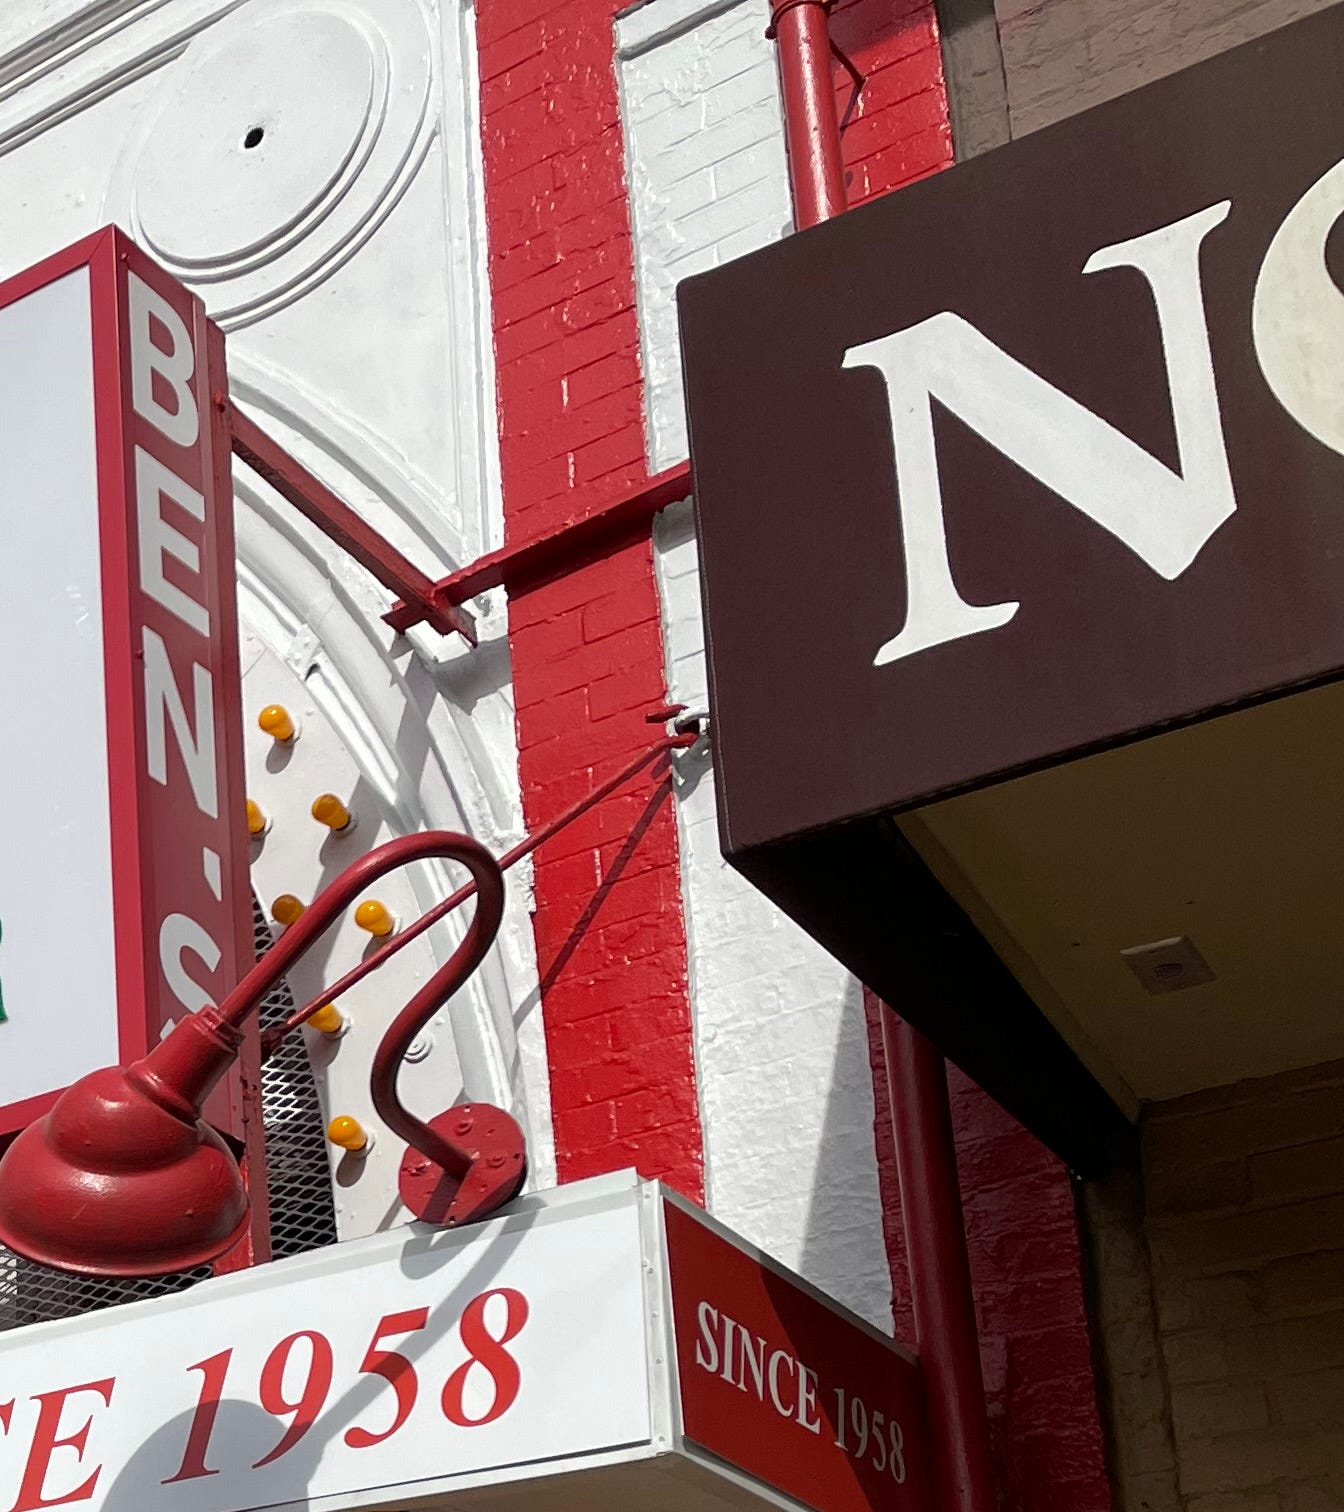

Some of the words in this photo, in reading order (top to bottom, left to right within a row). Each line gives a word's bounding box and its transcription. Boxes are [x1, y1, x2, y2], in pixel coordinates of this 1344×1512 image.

[160, 1286, 531, 1486] 1958
[695, 1301, 821, 1436] SINCE
[833, 1386, 907, 1486] 1958
